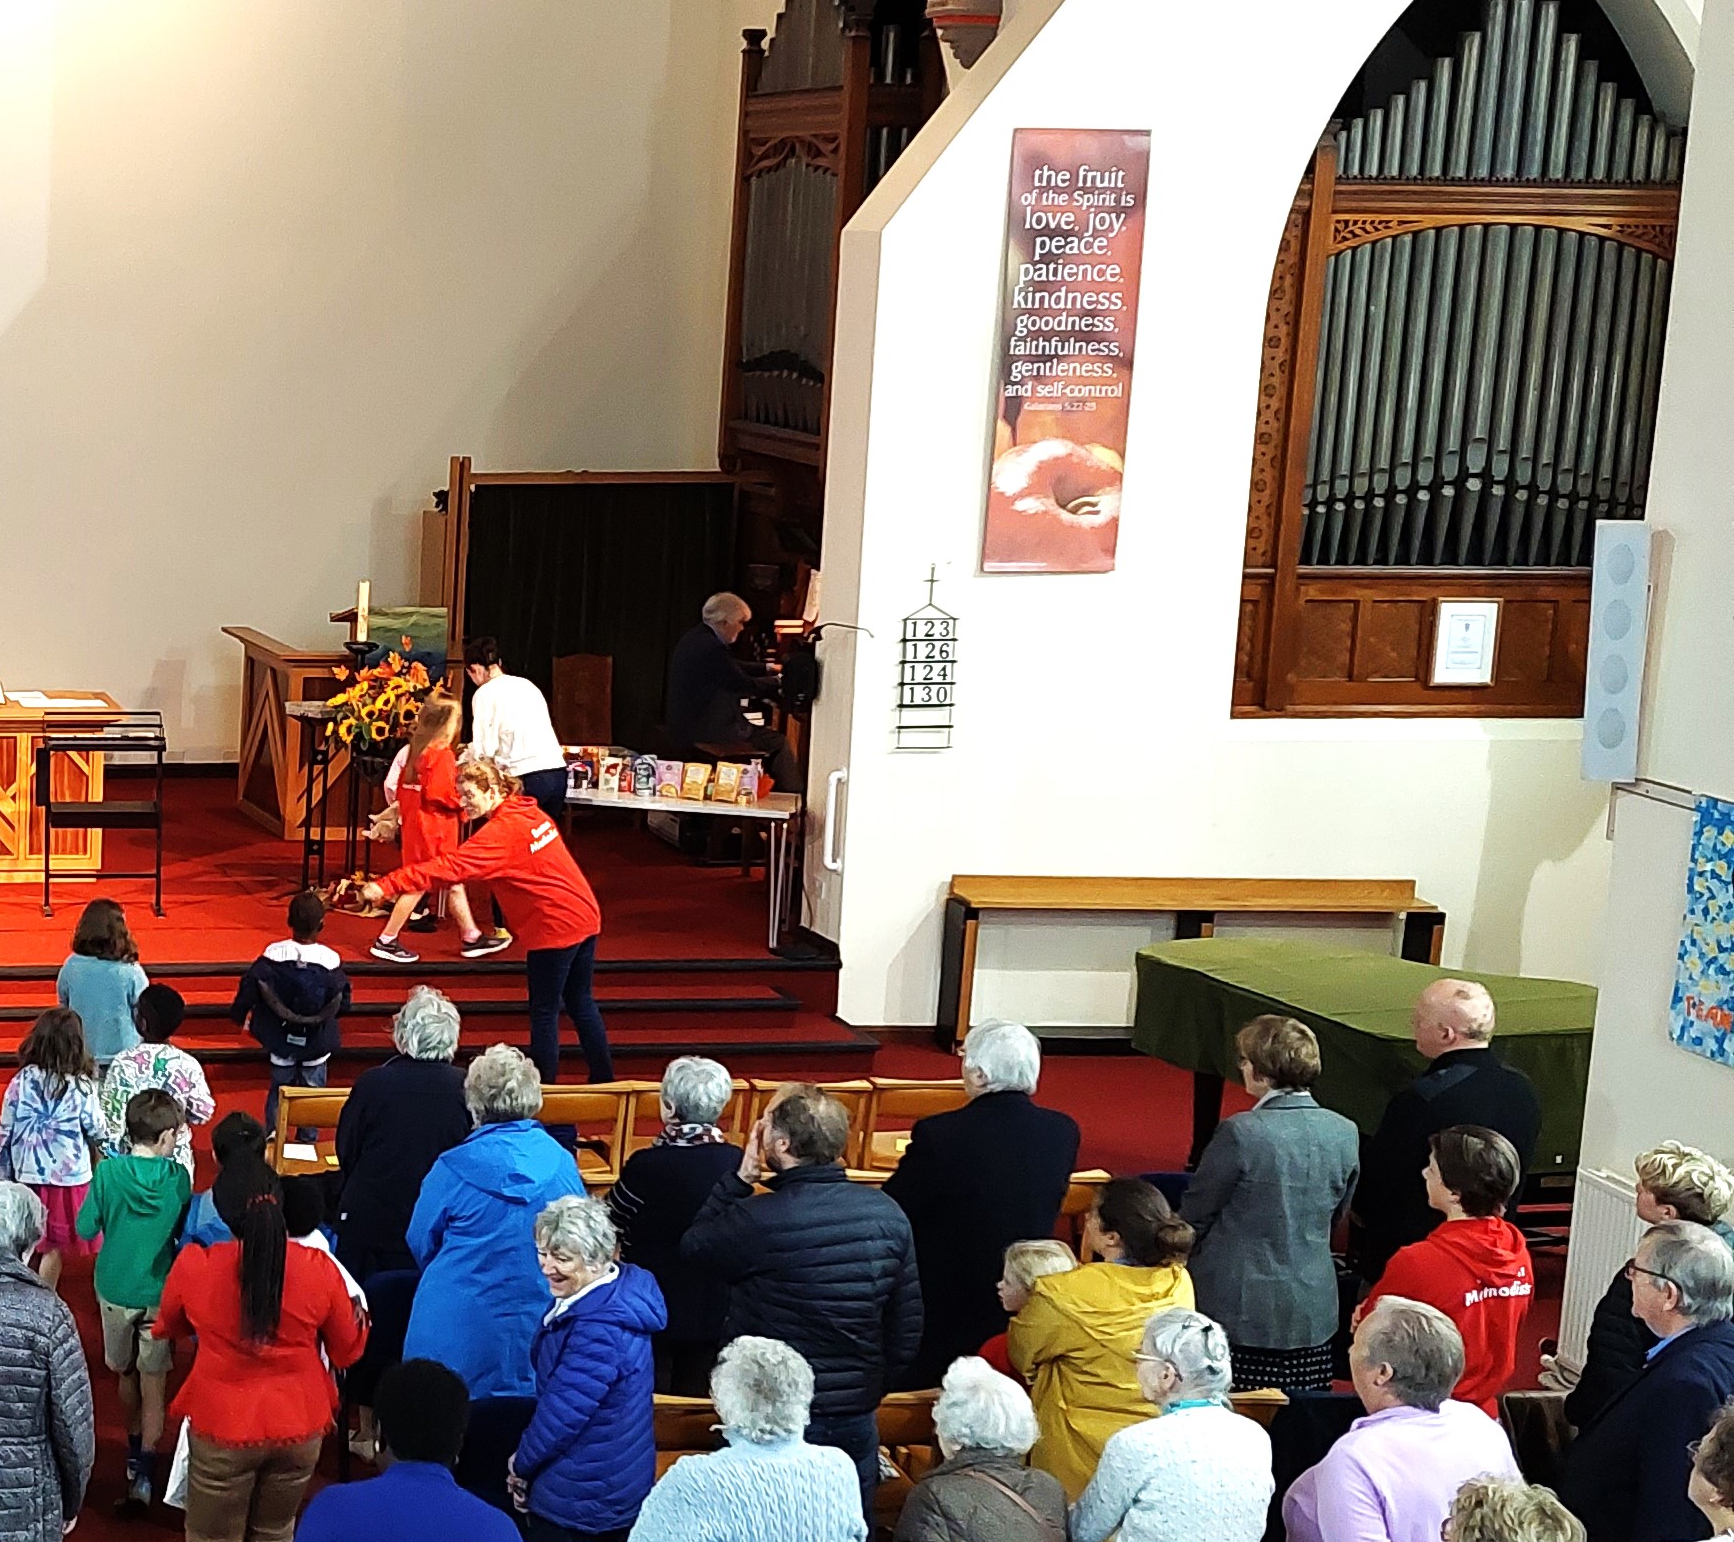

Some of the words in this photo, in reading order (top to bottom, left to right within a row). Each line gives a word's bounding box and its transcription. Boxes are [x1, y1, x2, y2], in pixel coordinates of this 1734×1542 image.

[1034, 164, 1071, 187] the
[1077, 165, 1126, 188] fruit
[1020, 189, 1039, 206] of
[1042, 189, 1069, 206] the
[1072, 190, 1117, 211] Spirit
[1120, 191, 1136, 207] is
[1004, 381, 1033, 397] and
[1035, 381, 1123, 398] self-control
[910, 620, 950, 637] 123
[912, 642, 950, 660] 126
[909, 664, 948, 681] 124
[908, 686, 948, 703] 130
